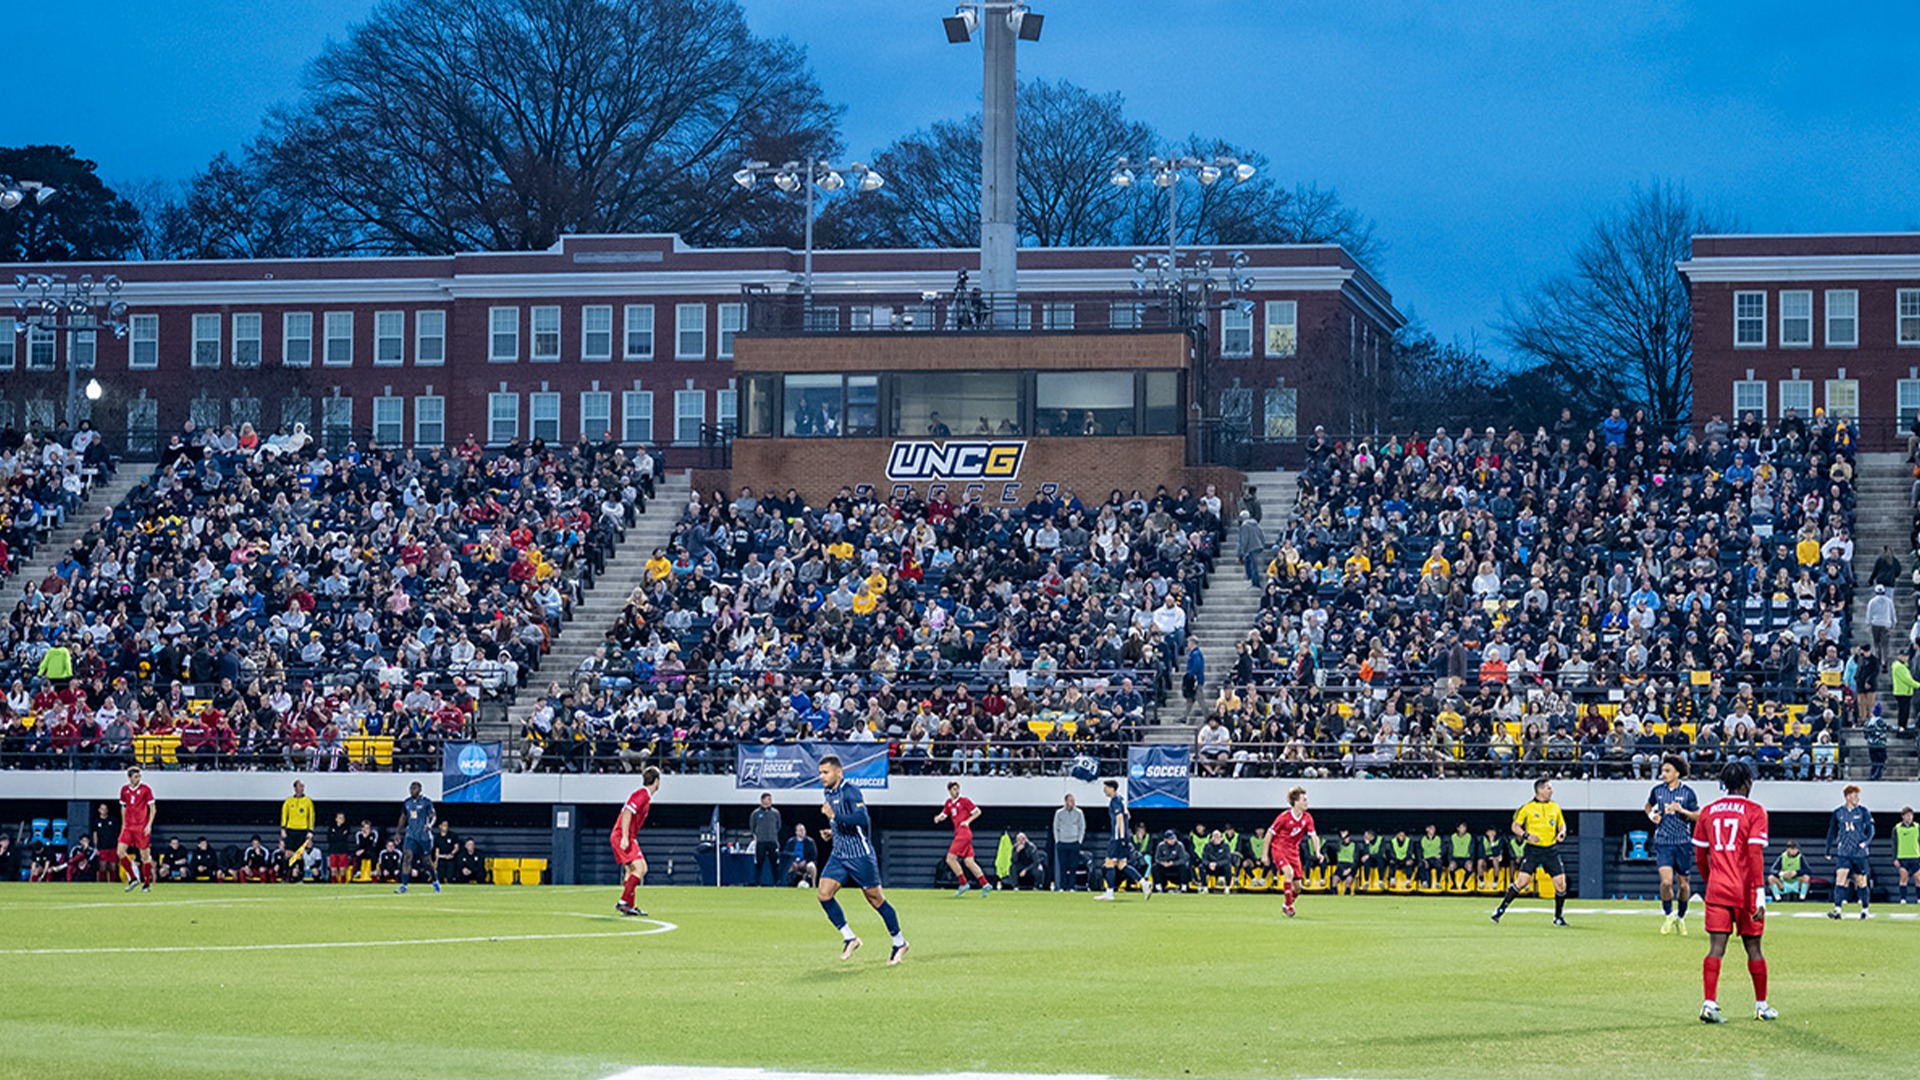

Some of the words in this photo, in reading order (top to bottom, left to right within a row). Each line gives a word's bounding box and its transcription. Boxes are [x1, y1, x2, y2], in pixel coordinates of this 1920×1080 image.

[887, 442, 1026, 480] UNCG
[763, 763, 792, 772] SOCCER
[1146, 765, 1187, 777] SOCCER
[1709, 802, 1745, 815] INDIANA
[1712, 818, 1739, 851] 17
